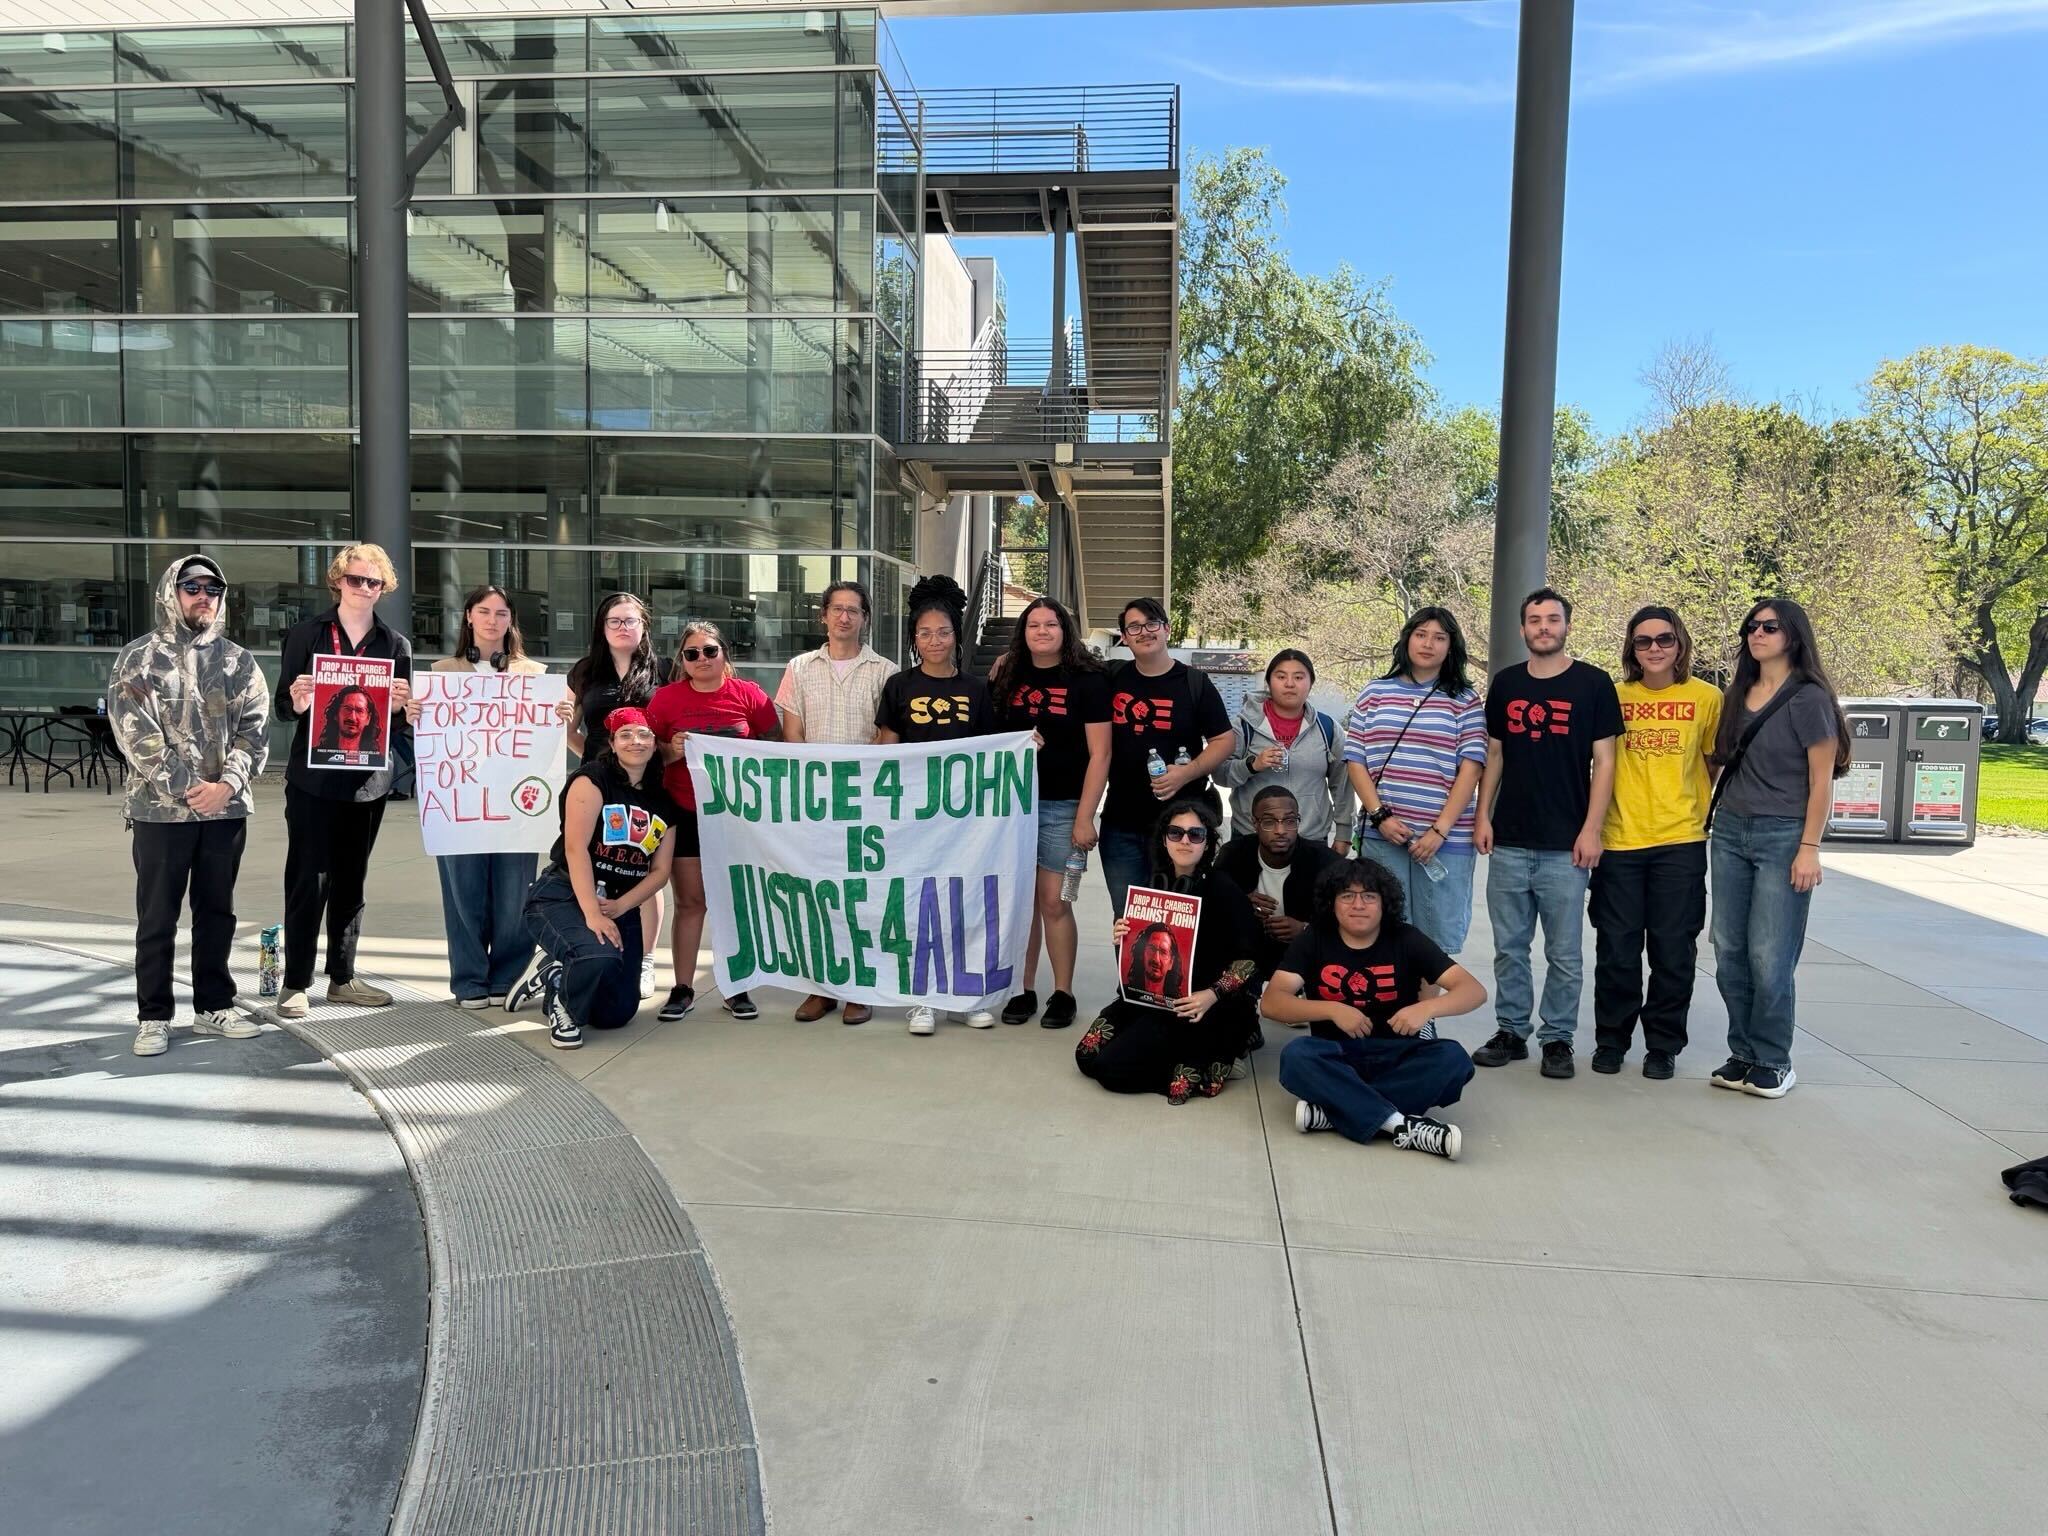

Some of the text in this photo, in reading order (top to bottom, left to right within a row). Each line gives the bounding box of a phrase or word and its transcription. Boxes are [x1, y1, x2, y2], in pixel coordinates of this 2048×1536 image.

[316, 671, 390, 688] AGAINST JOHN
[321, 661, 387, 675] DROP ALL CHARGES
[415, 674, 536, 701] JUSTICE
[419, 760, 478, 793] FOR
[703, 748, 1034, 823] JUSTICE 4 JOHN
[422, 787, 512, 827] ALL
[847, 825, 886, 872] IS
[1126, 904, 1196, 929] AGAINST JOHN
[1132, 893, 1194, 913] DROP ALL CHARGES
